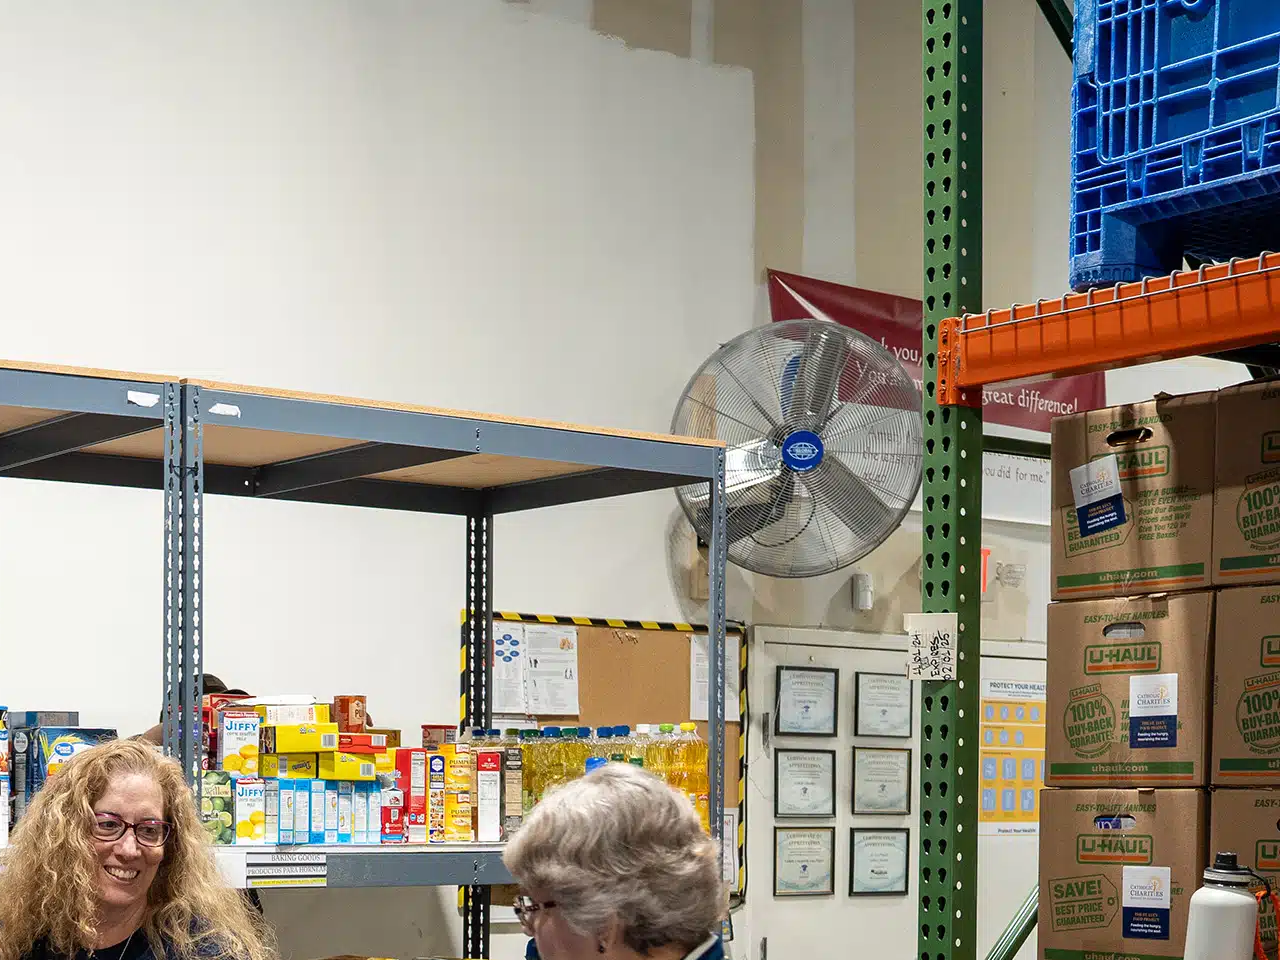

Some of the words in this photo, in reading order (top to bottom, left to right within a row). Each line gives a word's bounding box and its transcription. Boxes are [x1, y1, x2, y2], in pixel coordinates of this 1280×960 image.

[982, 390, 1014, 405] great
[1018, 389, 1078, 414] difference!
[1118, 451, 1165, 469] HAUL
[997, 468, 1011, 479] did
[1016, 467, 1027, 482] for
[1242, 509, 1280, 529] BUY-BA
[1244, 525, 1280, 542] GUARAN
[1069, 533, 1121, 552] GUARANTEED
[1099, 570, 1158, 582] uhaul.com
[1084, 612, 1132, 623] EASY-TO-LIFT
[1089, 647, 1156, 664] U-HAUL
[1071, 699, 1106, 722] 100%
[225, 720, 258, 731] JIFFY
[1069, 717, 1112, 738] BUY-BACK
[1242, 713, 1280, 731] BUY-BA
[1243, 727, 1280, 744] GUARAN
[1092, 763, 1148, 773] uhaul.com
[238, 787, 264, 797] JIFFY
[1076, 803, 1122, 812] EASY-TO-LIFT
[1123, 804, 1156, 812] HANDLES
[1081, 839, 1148, 853] U-HAUL
[1054, 880, 1102, 899] SAVE!
[1055, 904, 1076, 915] BEST
[1078, 902, 1103, 913] PRICE
[1056, 915, 1105, 926] GUARANTEED
